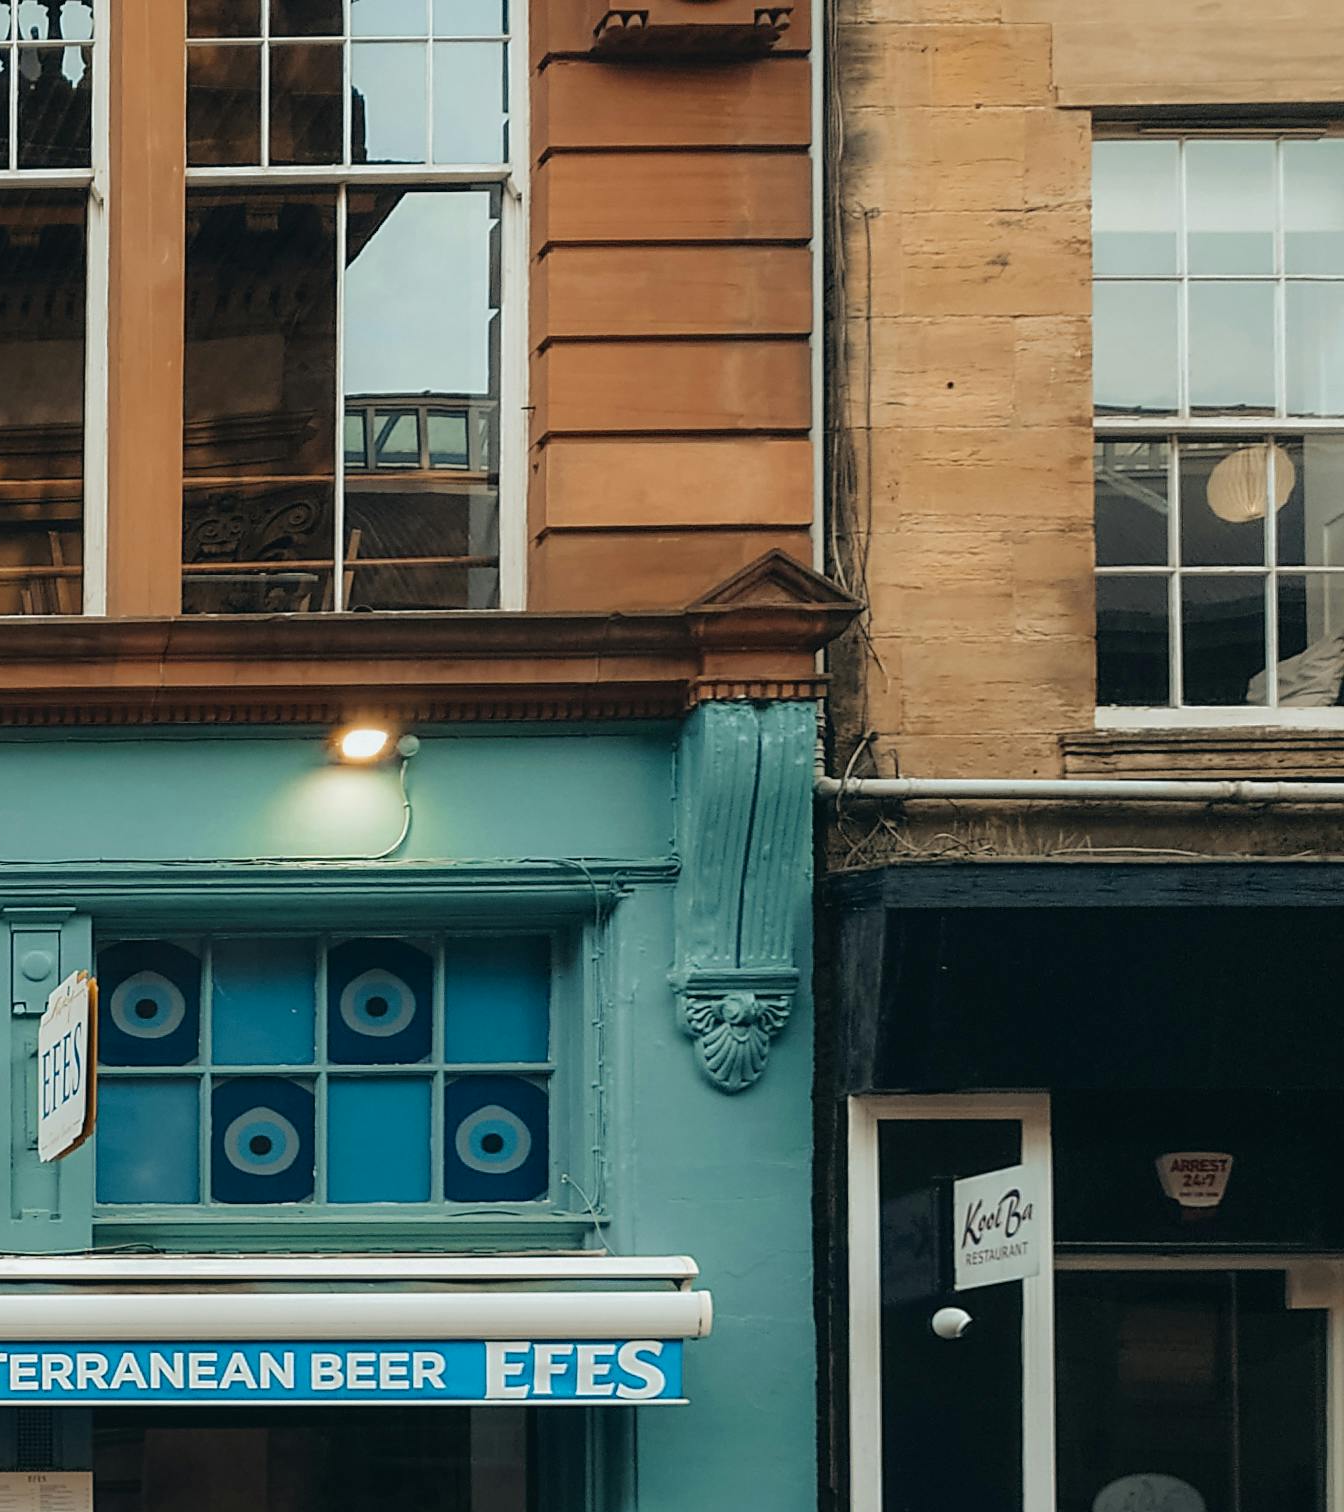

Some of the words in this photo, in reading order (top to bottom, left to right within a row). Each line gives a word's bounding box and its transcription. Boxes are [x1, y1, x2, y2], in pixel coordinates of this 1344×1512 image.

[42, 1022, 82, 1120] EFES
[1170, 1158, 1228, 1173] ARREST
[965, 1241, 1029, 1266] RESTAURANT
[311, 1352, 447, 1391] BEER
[484, 1340, 666, 1400] EFES
